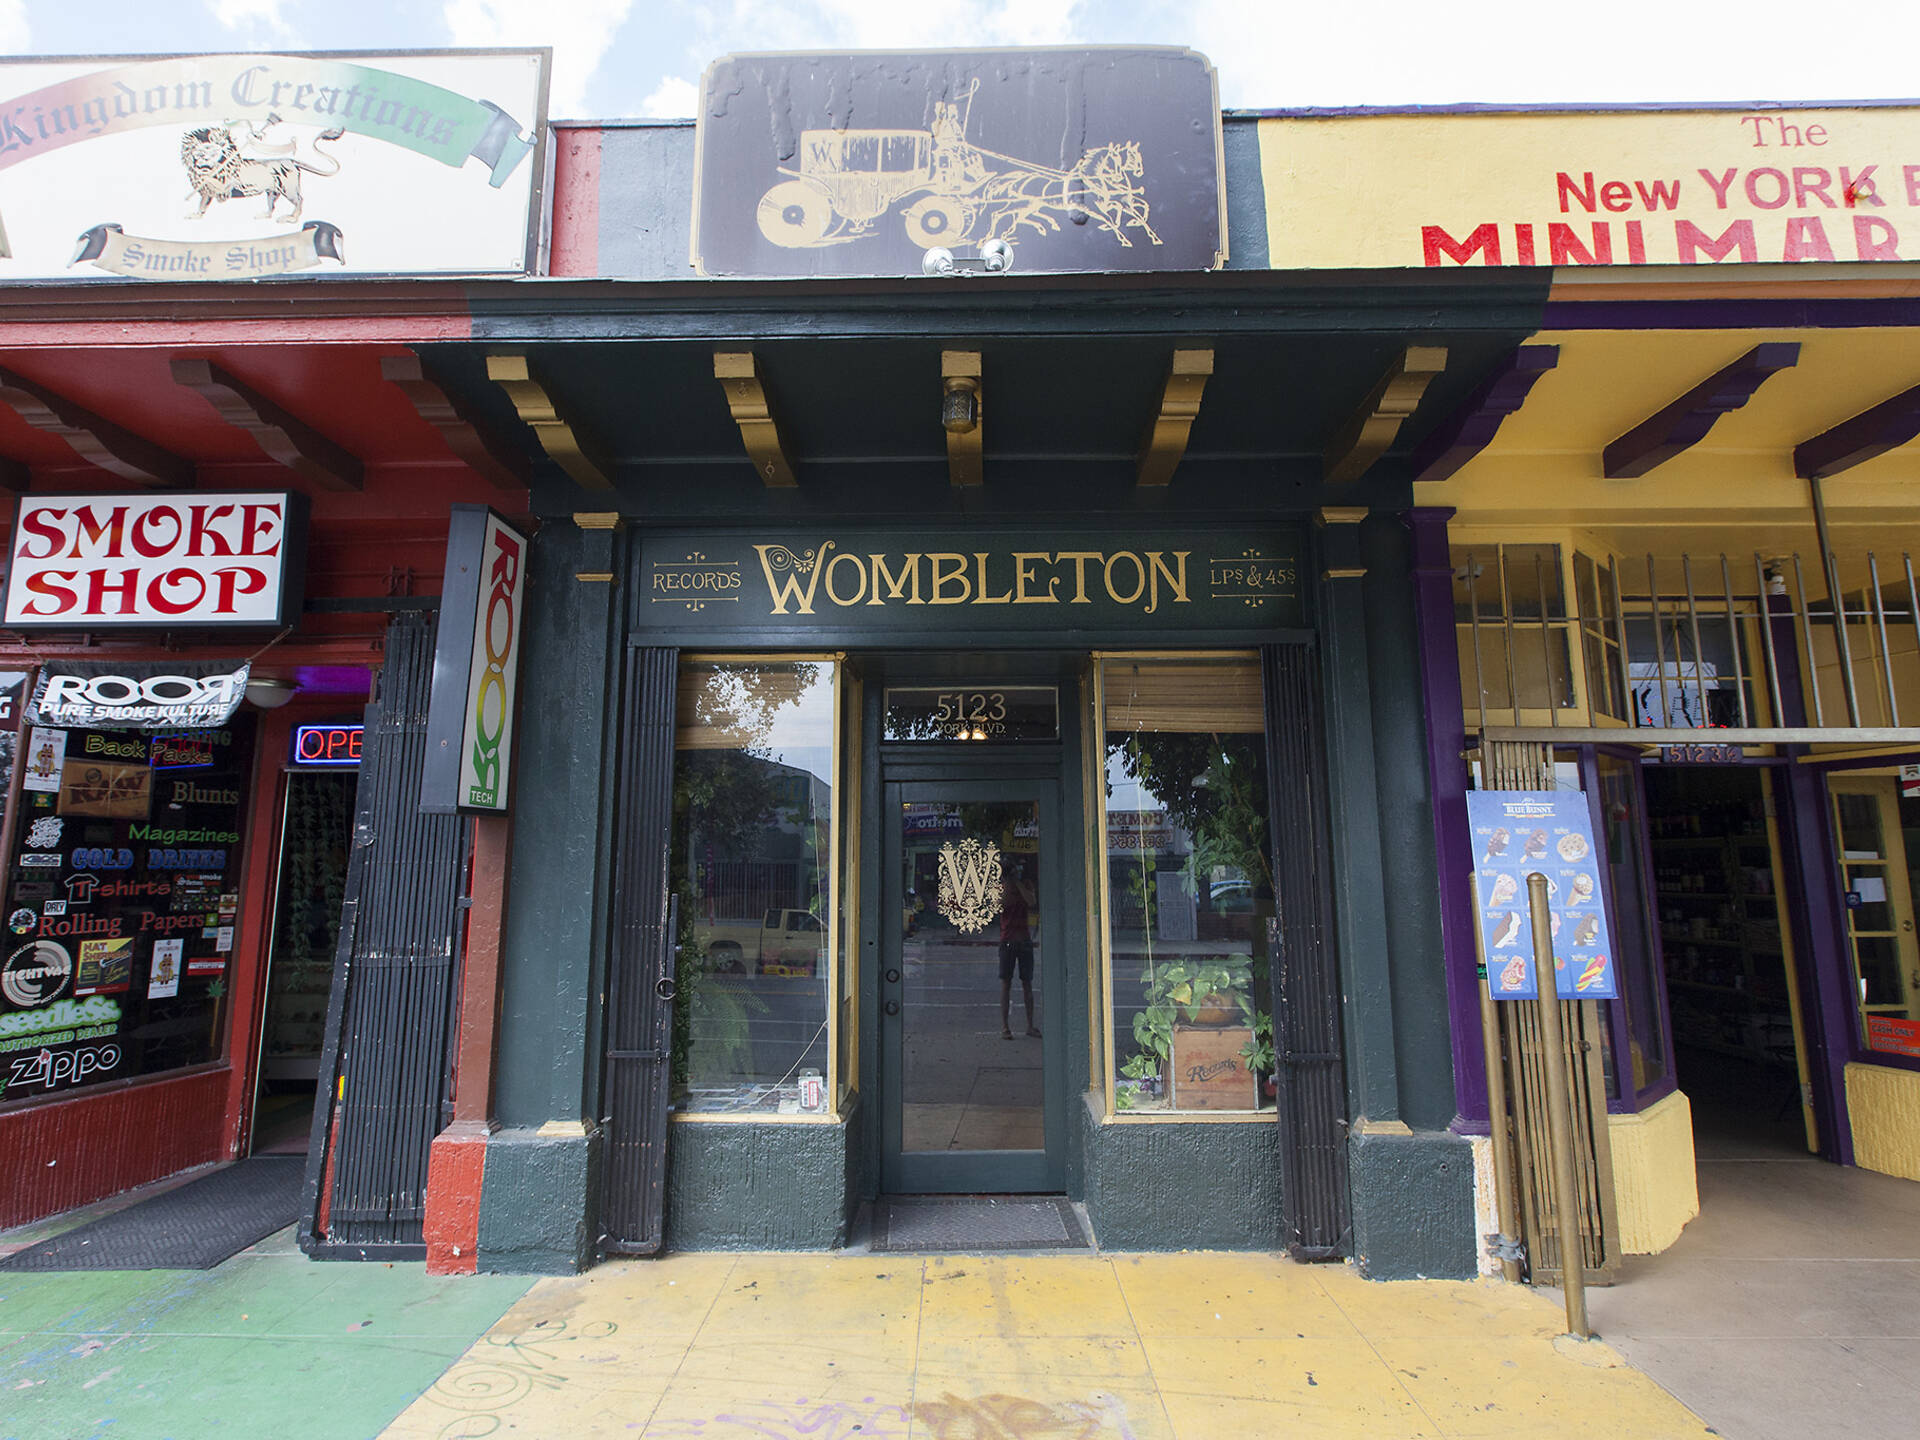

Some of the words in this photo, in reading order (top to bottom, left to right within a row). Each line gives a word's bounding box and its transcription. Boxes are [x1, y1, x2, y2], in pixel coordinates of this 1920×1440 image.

[0, 78, 213, 152] Kingdom
[231, 66, 461, 146] Creations
[1741, 116, 1829, 147] The
[1556, 171, 1681, 213] New
[122, 243, 212, 273] Smoke
[225, 244, 297, 273] Shop
[16, 503, 282, 559] SMOKE
[652, 571, 742, 593] RECORDS
[752, 540, 1192, 614] WOMBLETON
[1246, 565, 1264, 589] &
[20, 566, 268, 616] SHOP
[38, 702, 93, 717] PURE
[93, 703, 158, 719] SMOKE
[158, 702, 230, 719] KULTURE
[935, 693, 1007, 721] 5123
[936, 723, 968, 735] YORK
[85, 735, 146, 759] Back
[150, 742, 214, 765] Packs
[300, 730, 365, 759] OPE
[172, 781, 239, 805] Blunts
[471, 789, 494, 804] TECH
[1506, 805, 1526, 814] BLUE
[1526, 805, 1553, 814] BUNNY
[129, 824, 240, 844] Magazines
[71, 848, 134, 870] COLD
[147, 849, 226, 869] DRINKS
[75, 878, 171, 898] T-shirts
[37, 914, 123, 937] Rolling
[140, 911, 204, 935] Papers
[84, 942, 108, 952] NAT
[76, 1024, 118, 1040] DEALER
[1186, 1057, 1238, 1082] Records
